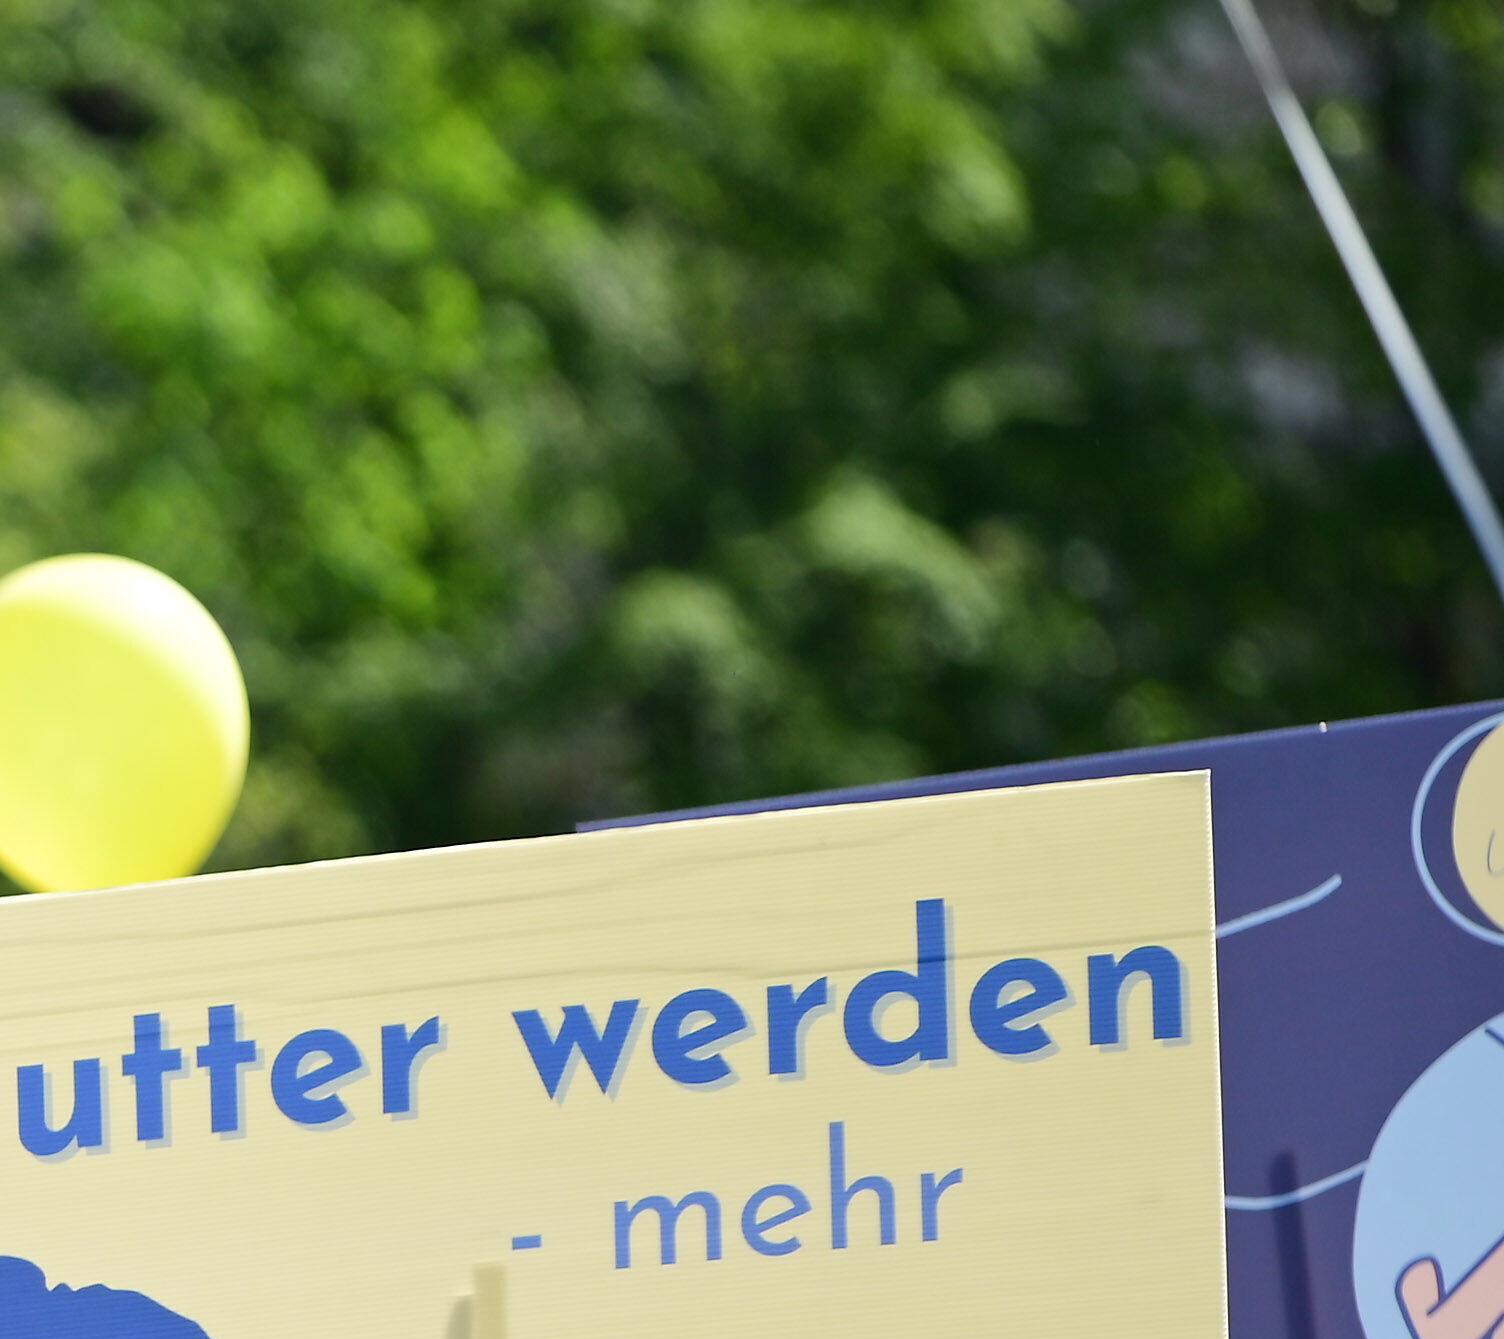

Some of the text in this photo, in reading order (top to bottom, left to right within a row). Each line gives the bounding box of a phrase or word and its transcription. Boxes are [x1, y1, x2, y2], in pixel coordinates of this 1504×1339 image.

[512, 898, 1190, 1105] werden
[511, 1121, 964, 1271] - mehr
